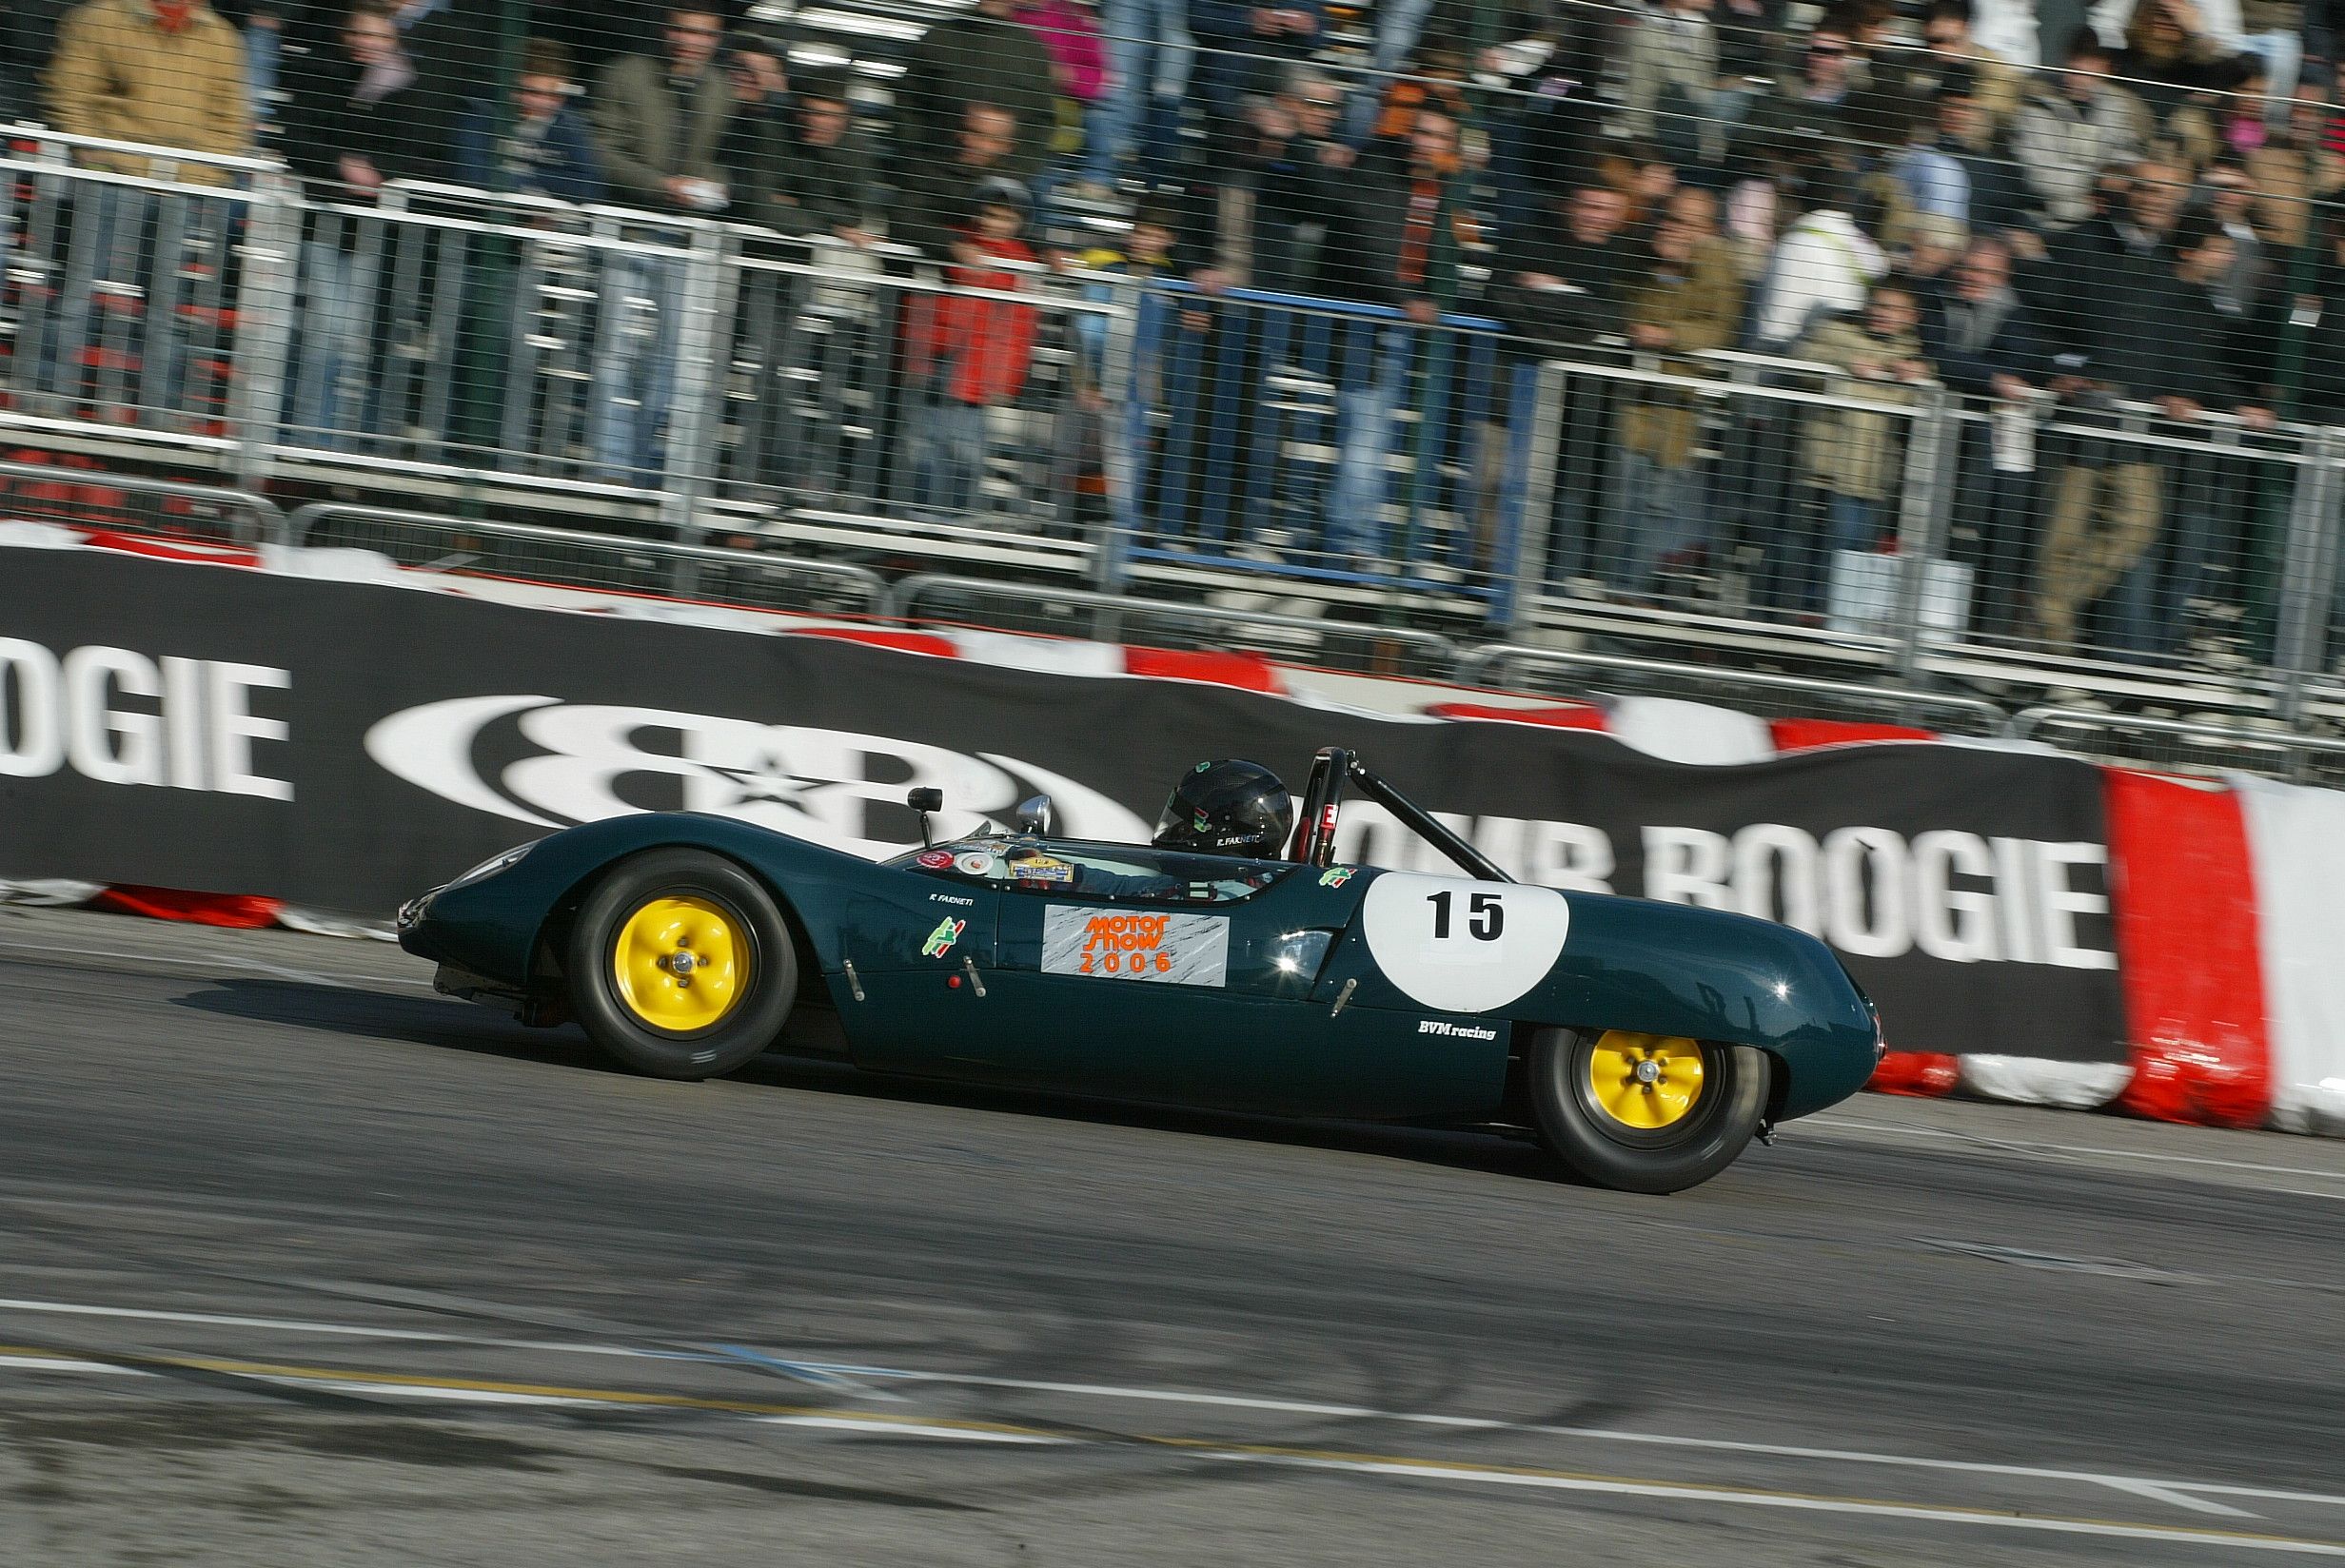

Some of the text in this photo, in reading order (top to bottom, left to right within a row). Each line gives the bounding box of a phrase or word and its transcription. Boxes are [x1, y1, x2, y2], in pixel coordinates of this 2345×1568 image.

[1427, 891, 1504, 941] 15
[1640, 822, 2119, 970] BOOGIE
[1079, 952, 1172, 973] 2006
